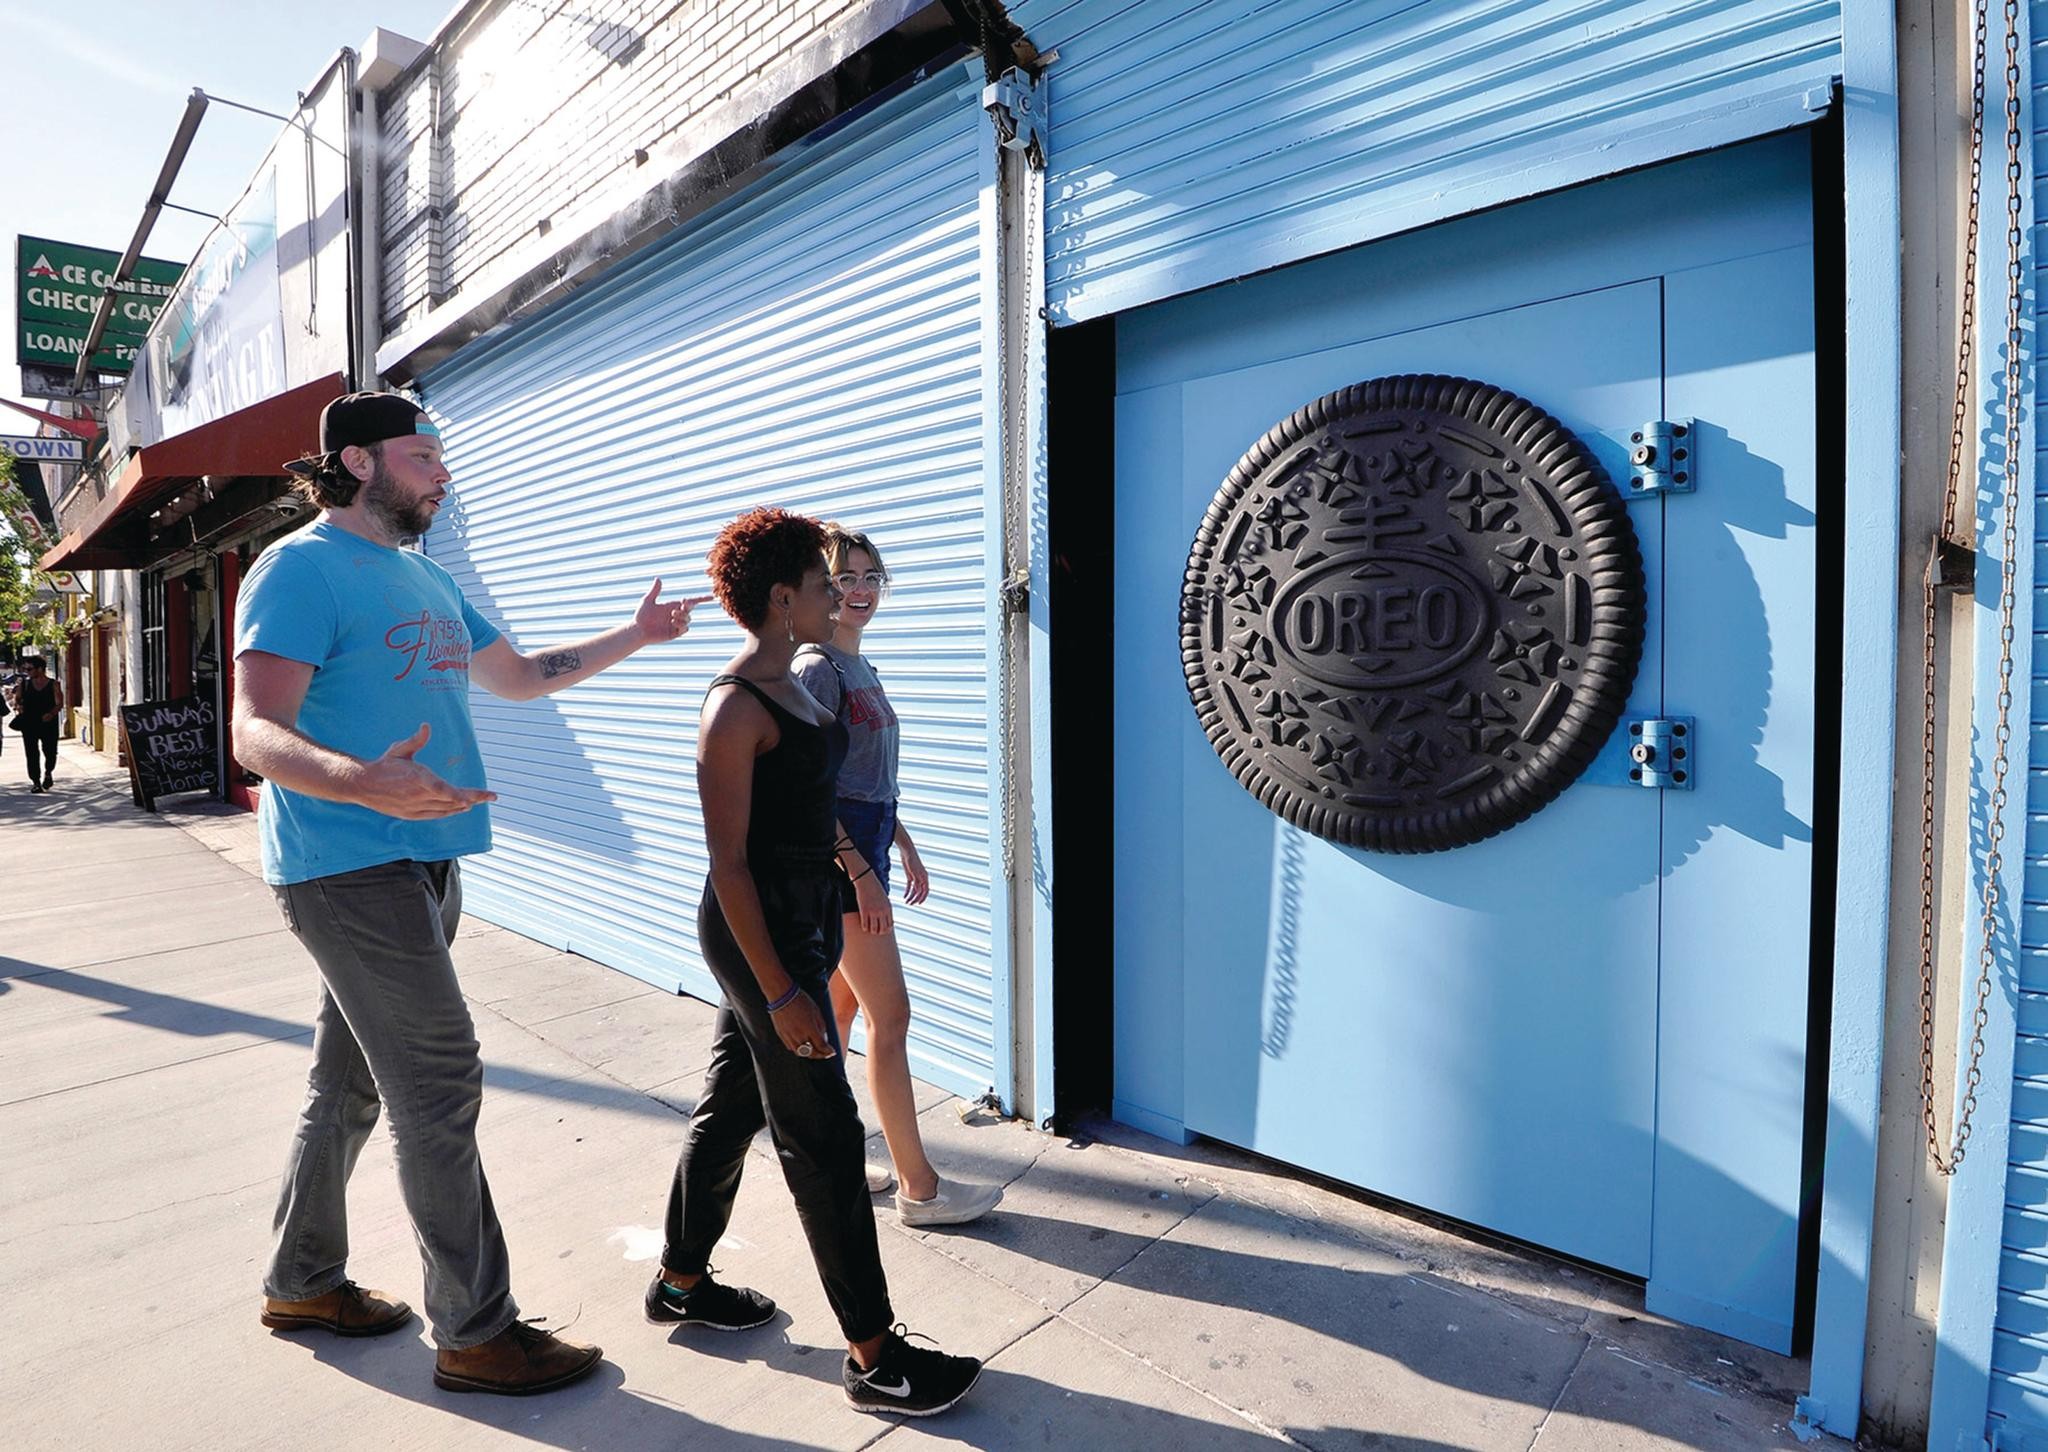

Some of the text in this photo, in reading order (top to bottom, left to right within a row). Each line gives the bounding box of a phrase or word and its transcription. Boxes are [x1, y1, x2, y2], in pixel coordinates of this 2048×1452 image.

[26, 332, 87, 354] LOAN
[433, 619, 463, 640] 1959
[1291, 584, 1459, 652] OREO
[148, 728, 204, 758] BEST
